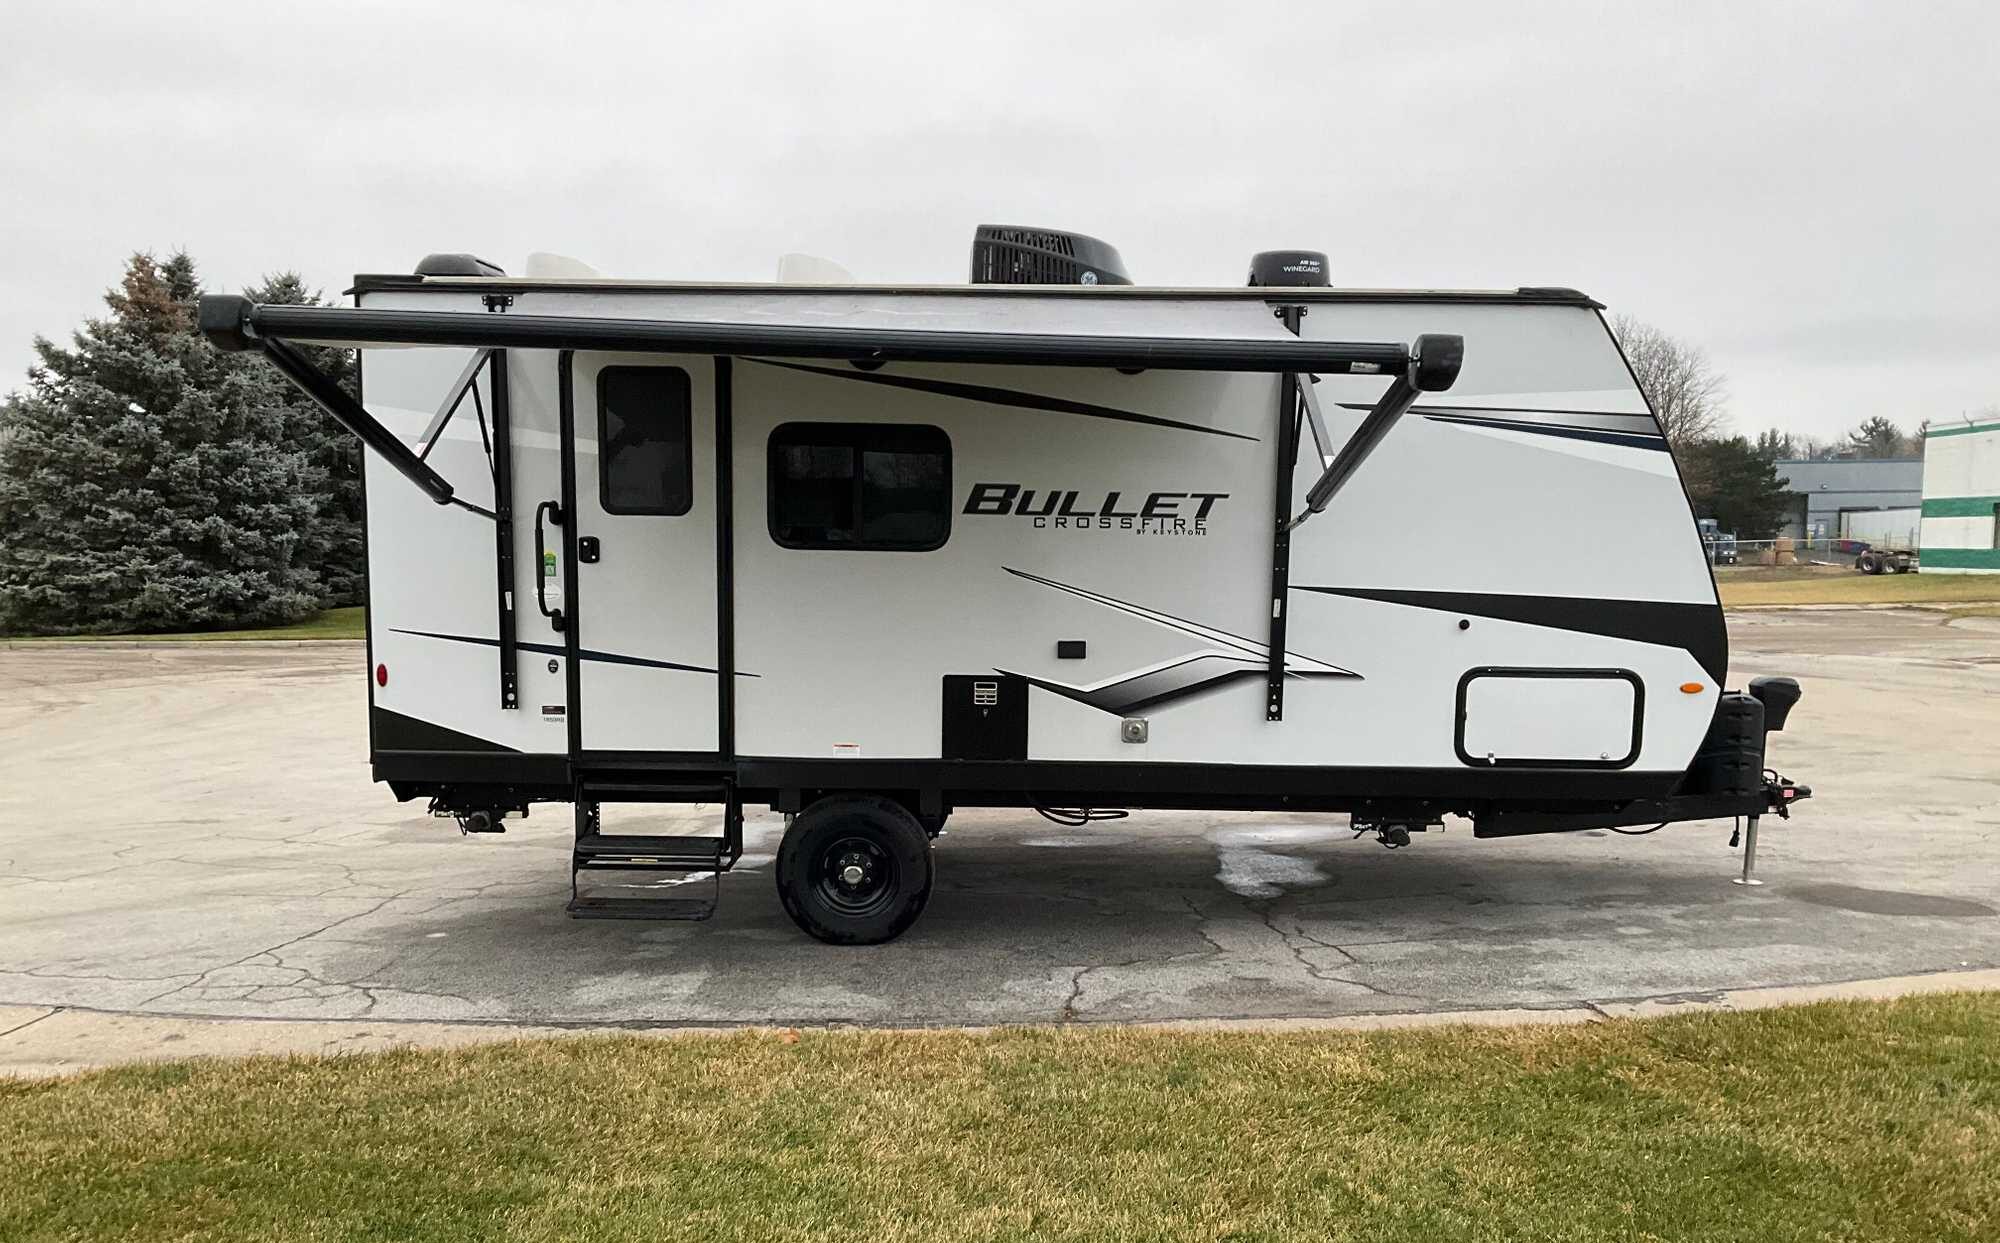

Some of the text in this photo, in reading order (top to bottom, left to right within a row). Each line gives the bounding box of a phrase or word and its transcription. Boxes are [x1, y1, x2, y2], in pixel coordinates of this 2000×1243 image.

[1283, 265, 1320, 273] WINEGARD
[962, 483, 1230, 518] BULLET
[1033, 516, 1207, 530] CROSSFIRE
